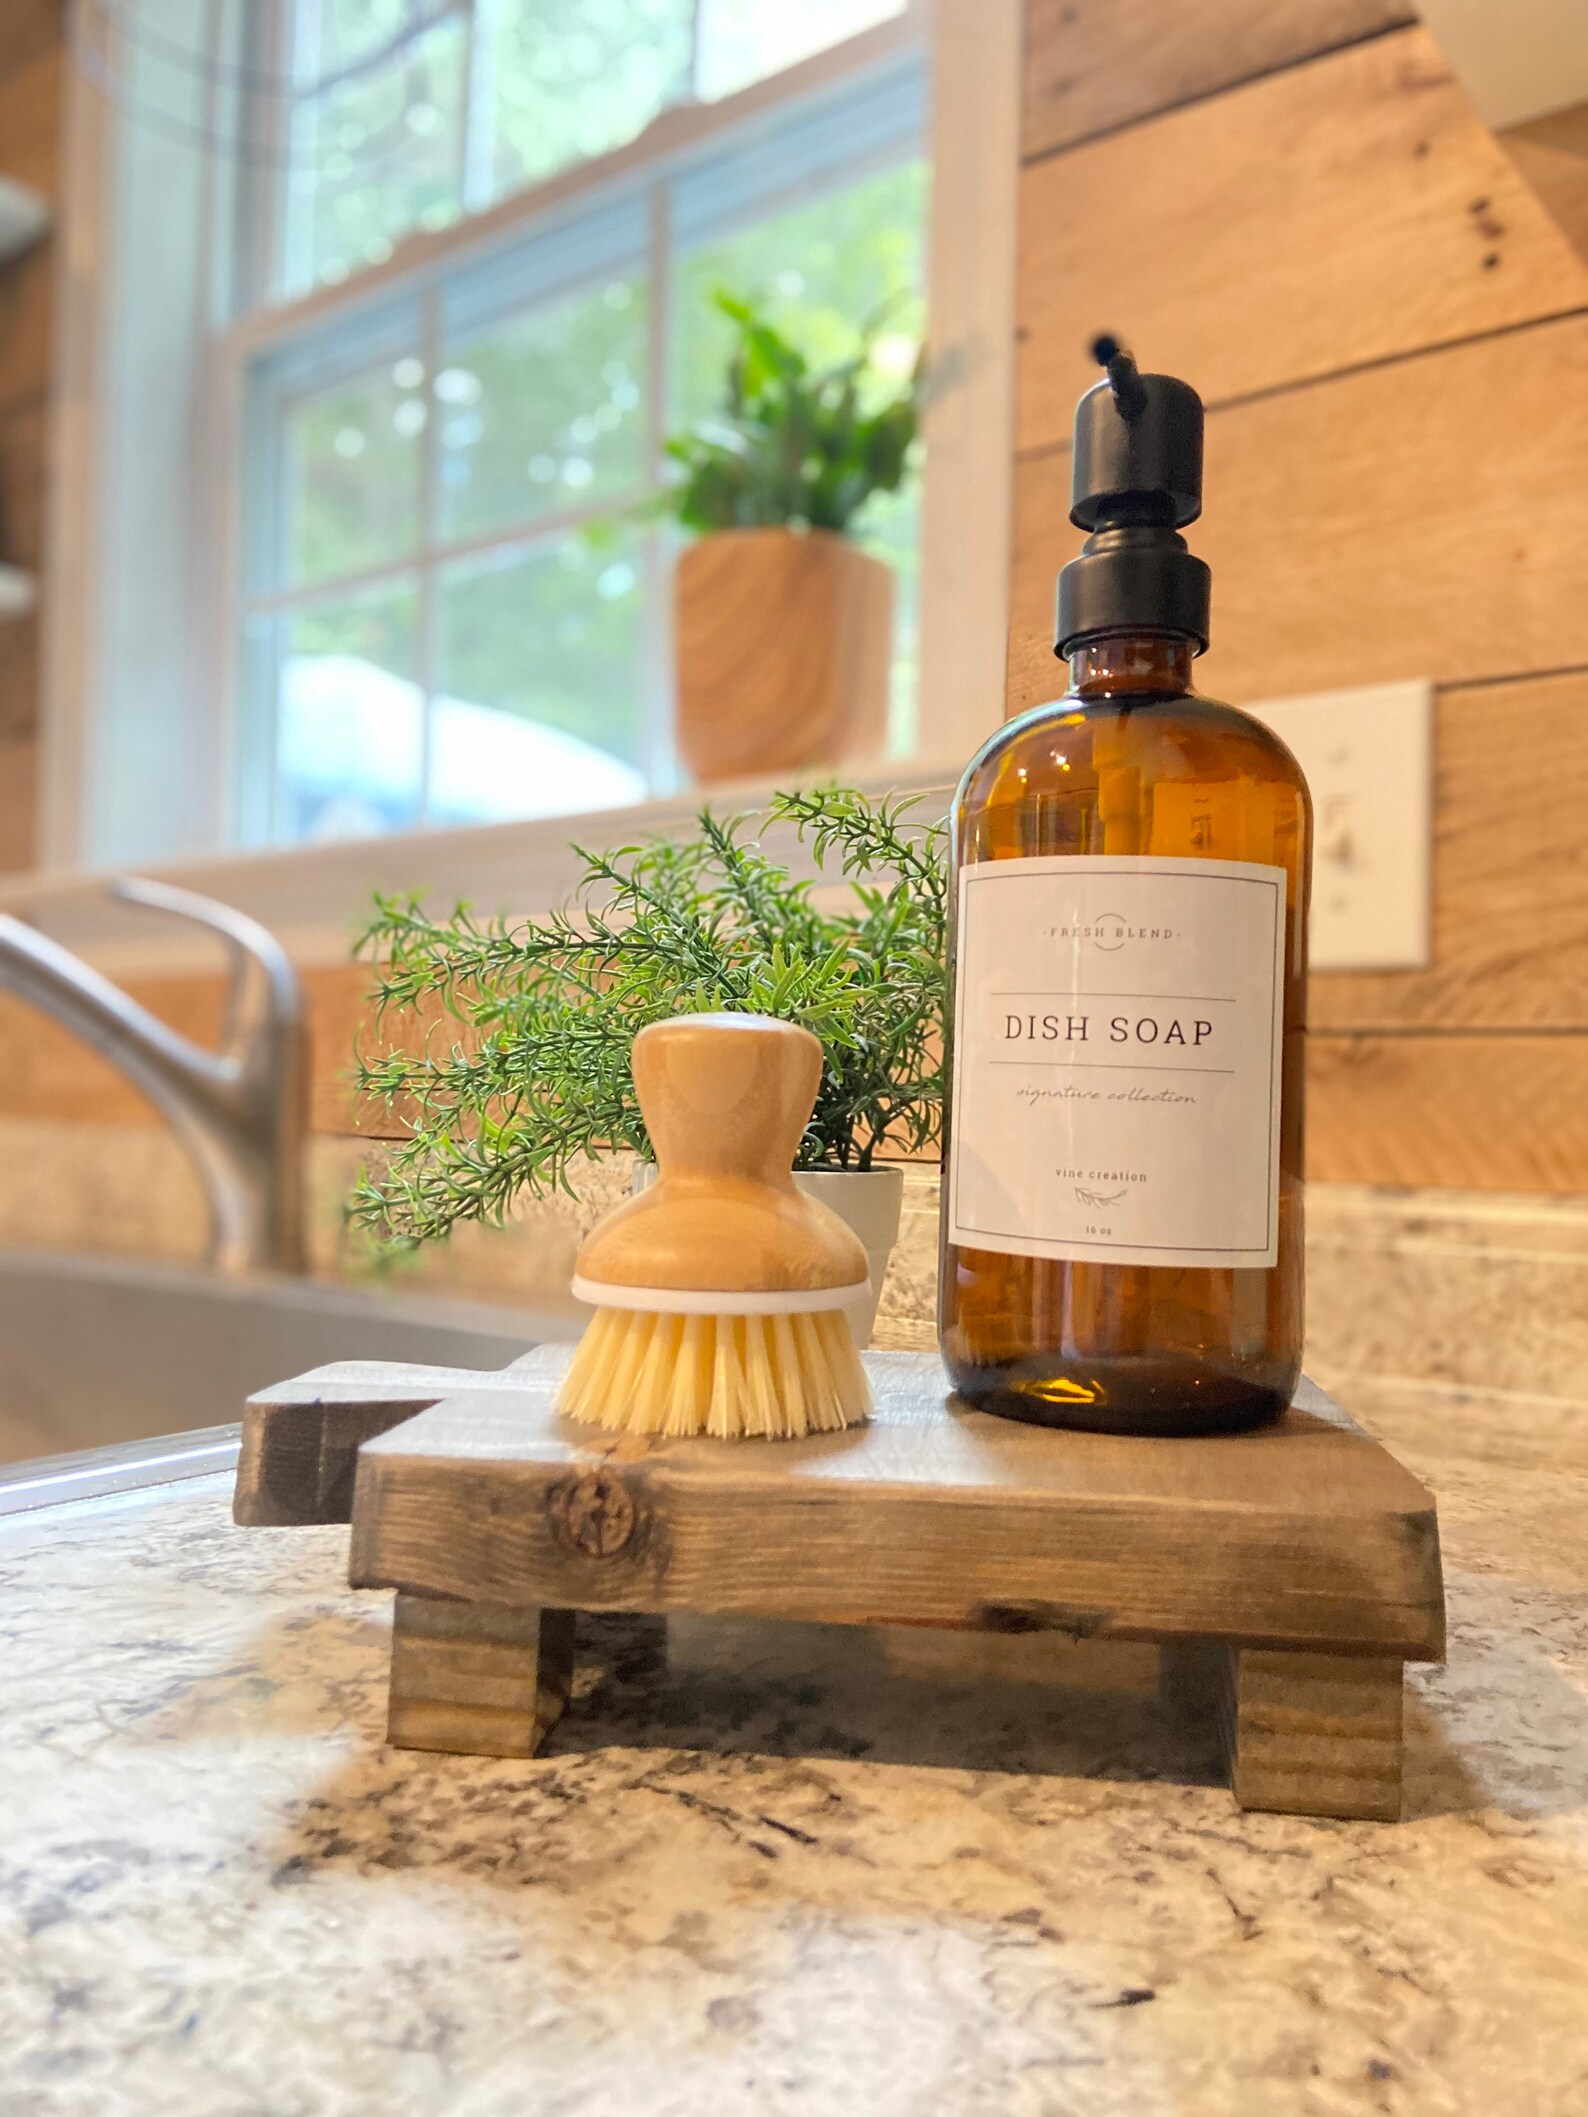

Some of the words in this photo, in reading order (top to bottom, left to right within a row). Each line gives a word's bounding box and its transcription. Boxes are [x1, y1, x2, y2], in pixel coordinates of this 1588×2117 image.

[1050, 927, 1104, 938] FRESH
[1115, 927, 1173, 939] BLEND
[1004, 1015, 1089, 1041] DISH
[1110, 1017, 1213, 1046] SOAP
[1017, 1084, 1101, 1106] signature
[1107, 1087, 1196, 1104] collection
[1055, 1168, 1083, 1178] vine
[1089, 1170, 1147, 1182] creation
[1086, 1225, 1096, 1234] 16
[1100, 1226, 1112, 1236] oz
